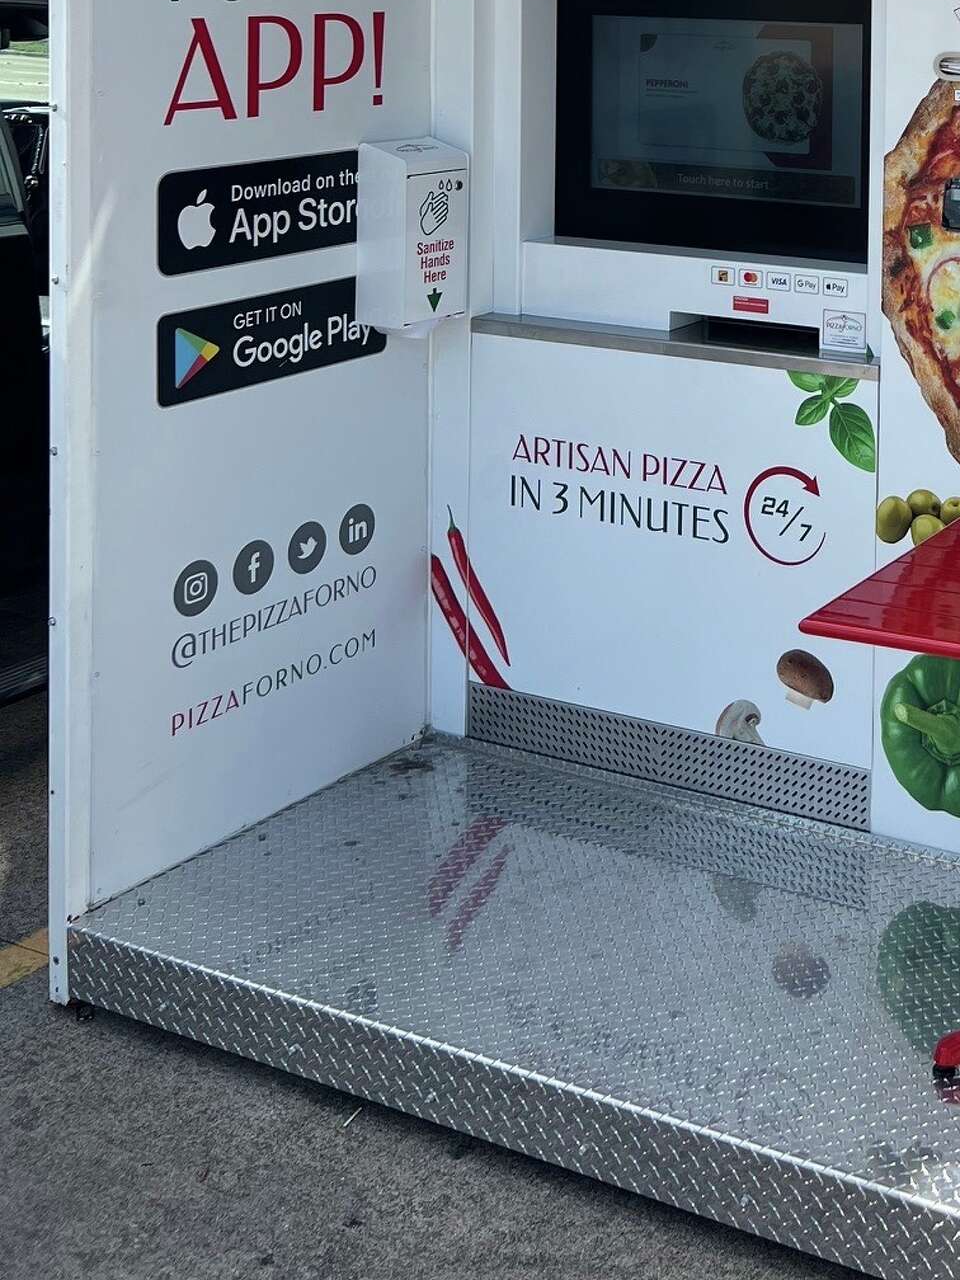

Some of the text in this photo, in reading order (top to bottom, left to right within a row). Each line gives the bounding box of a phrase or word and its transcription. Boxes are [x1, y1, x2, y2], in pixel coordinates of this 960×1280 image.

[163, 11, 386, 126] APP!
[645, 79, 689, 89] PEPPERONI
[231, 173, 311, 202] Download
[316, 175, 335, 190] on
[676, 173, 706, 185] Touch
[229, 196, 358, 246] App Stor
[416, 239, 455, 256] Sanitize
[420, 253, 451, 271] Hands
[423, 269, 447, 284] Here
[771, 277, 788, 286] VISA
[804, 280, 817, 290] Pay
[831, 283, 845, 293] Pay
[233, 301, 302, 330] GET IT ON
[232, 313, 371, 368] Google Play
[512, 433, 728, 495] ARTISAN PIZZA
[511, 475, 730, 544] IN 3 MINUTES
[760, 496, 812, 542] 24/7
[171, 565, 377, 669] @THEPIZZAFORNO
[171, 628, 376, 737] PIZZAFORNO.COM
